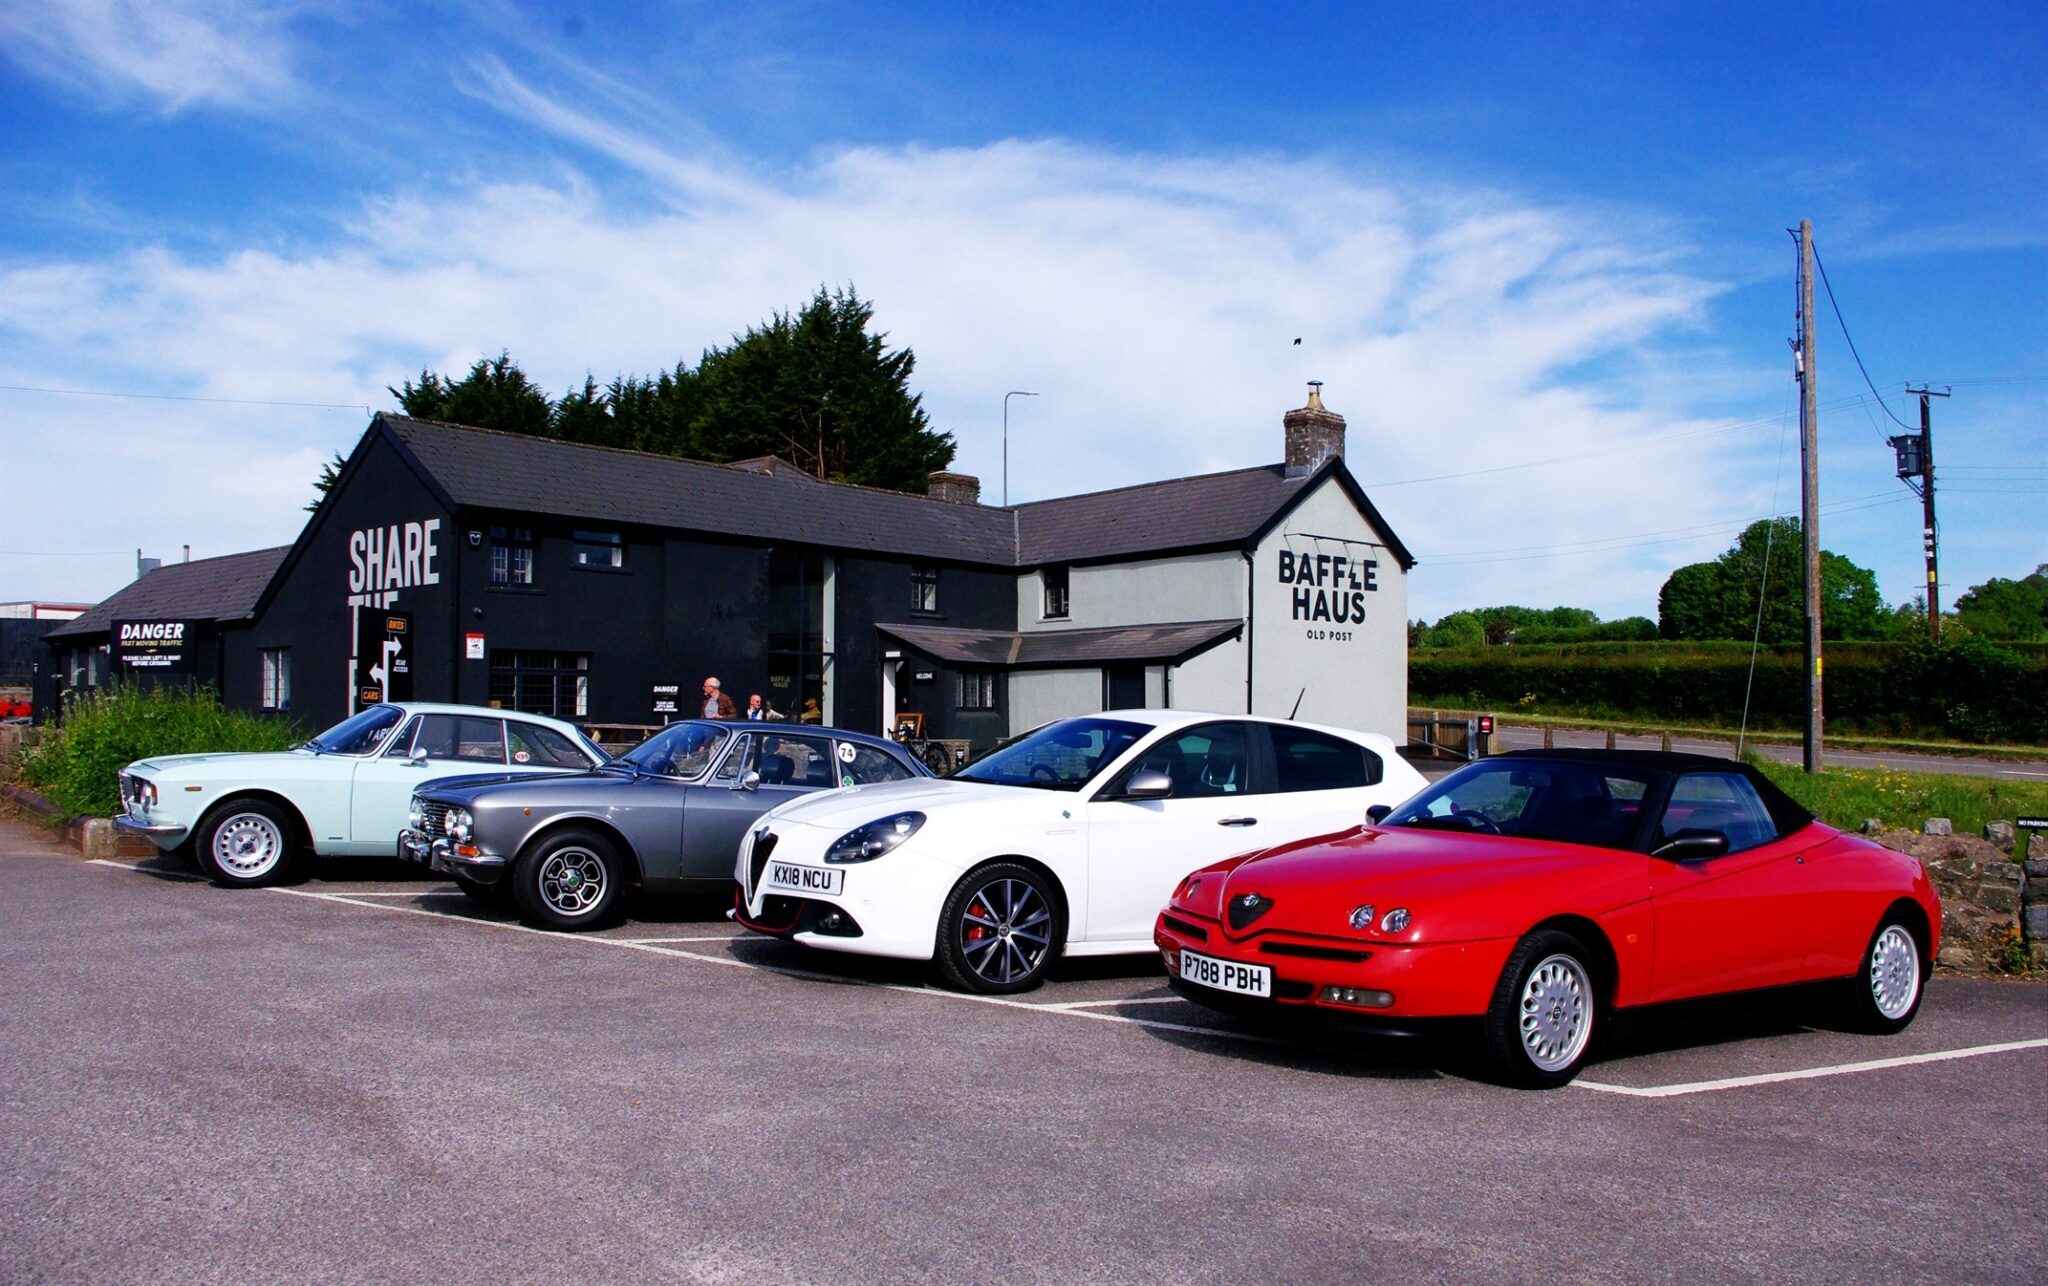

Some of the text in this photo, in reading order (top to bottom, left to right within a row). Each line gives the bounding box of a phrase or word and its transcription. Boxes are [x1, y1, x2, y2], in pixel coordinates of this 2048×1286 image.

[349, 518, 440, 593] SHARE
[1278, 549, 1378, 592] BAFFLE
[1292, 587, 1366, 625] HAUS
[121, 624, 184, 639] DANGER
[1306, 629, 1353, 641] OLD POST
[363, 691, 379, 700] CARS
[653, 685, 679, 693] DANGER
[841, 747, 853, 758] 74
[774, 864, 832, 889] KX18 NCU
[1184, 954, 1262, 992] P788 PBH
